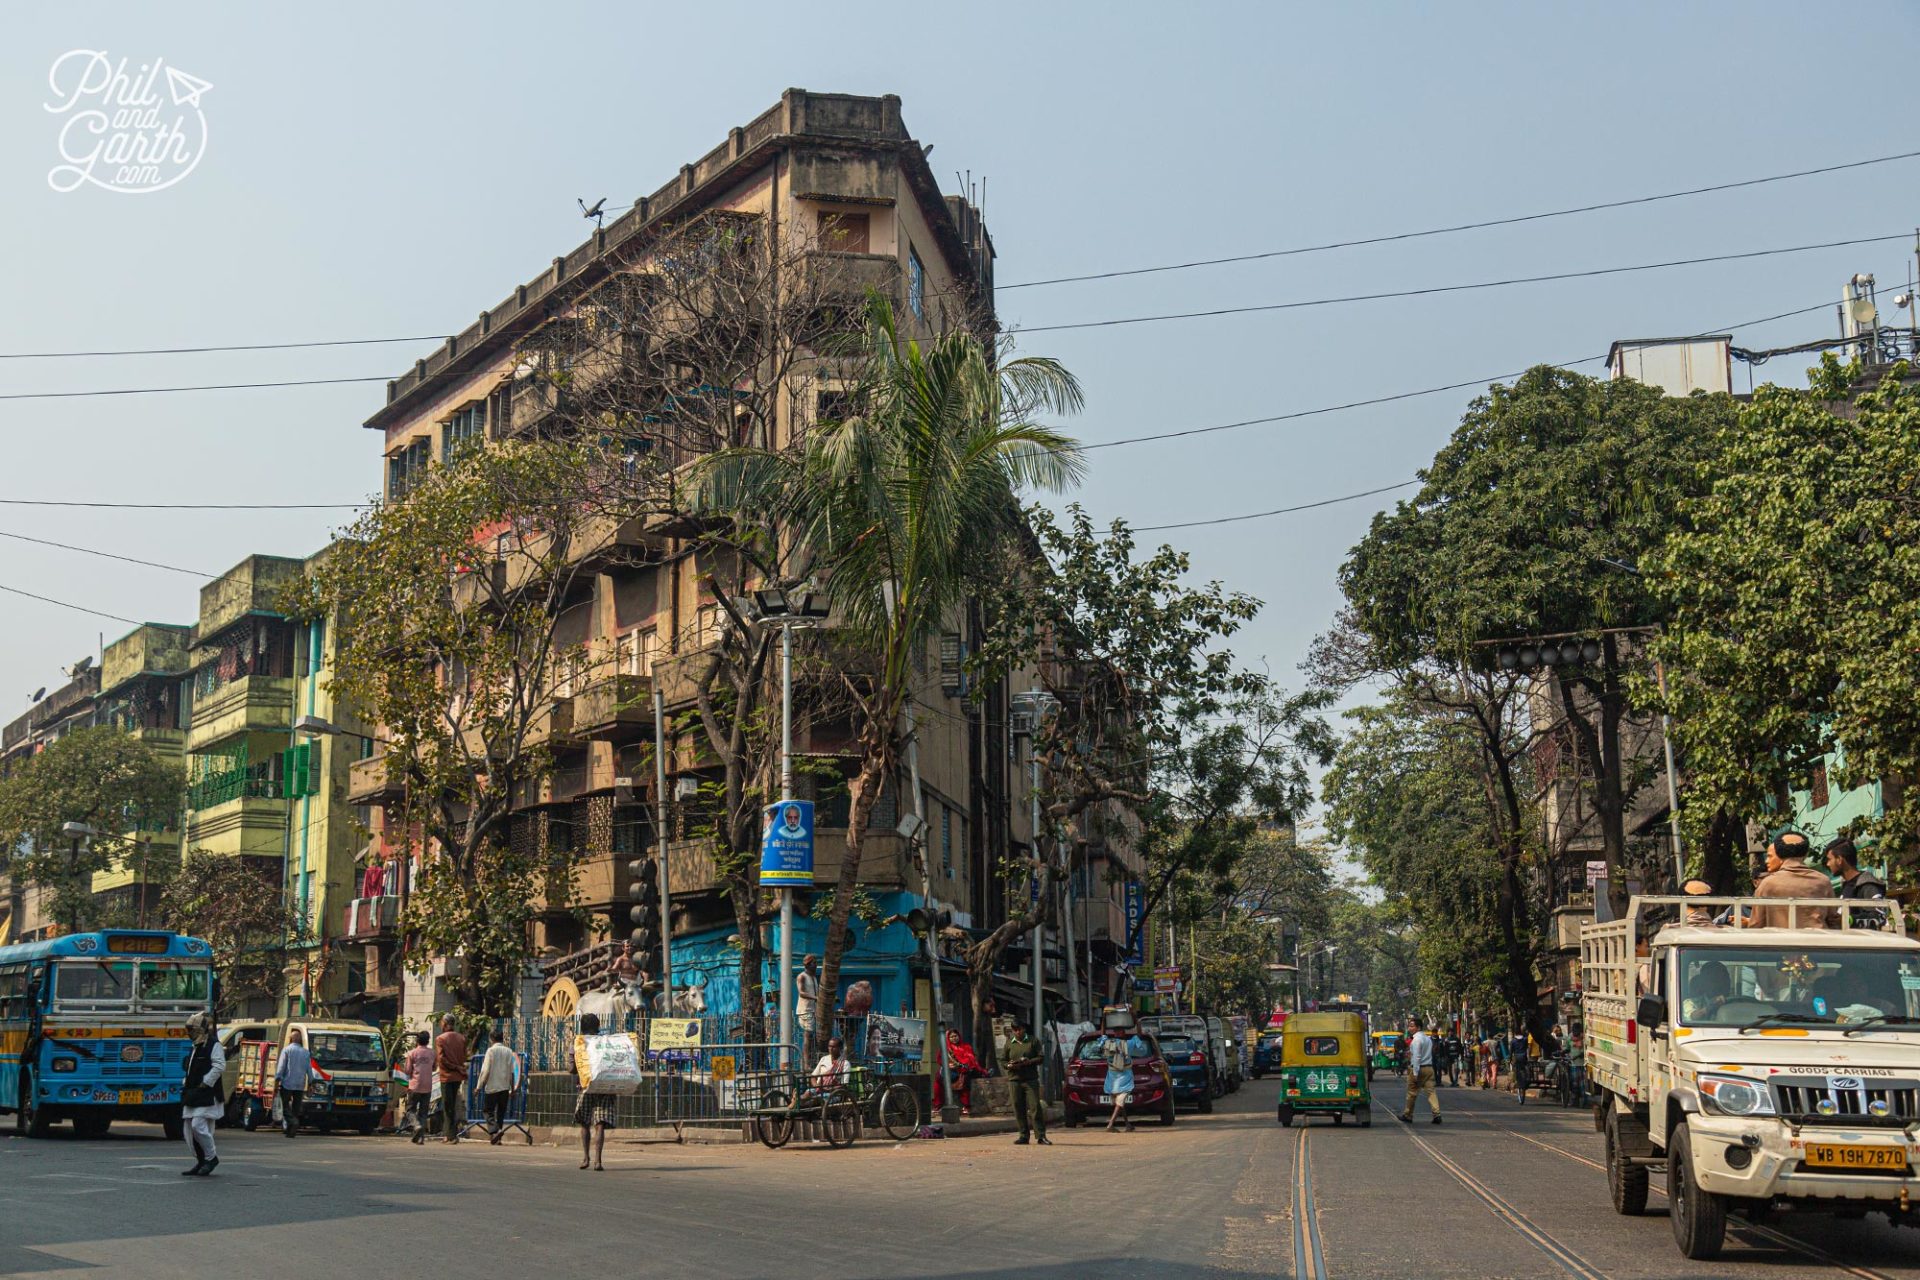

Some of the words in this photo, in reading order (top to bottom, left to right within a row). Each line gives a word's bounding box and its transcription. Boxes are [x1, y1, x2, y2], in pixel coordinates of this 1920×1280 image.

[1128, 885, 1139, 953] BADSA
[1789, 1067, 1829, 1075] GOODS
[1834, 1068, 1896, 1076] CARRIAGE
[93, 1089, 117, 1101] SPEED
[1816, 1148, 1834, 1161] WB
[1839, 1149, 1864, 1162] 19H
[1867, 1150, 1903, 1164] 7870
